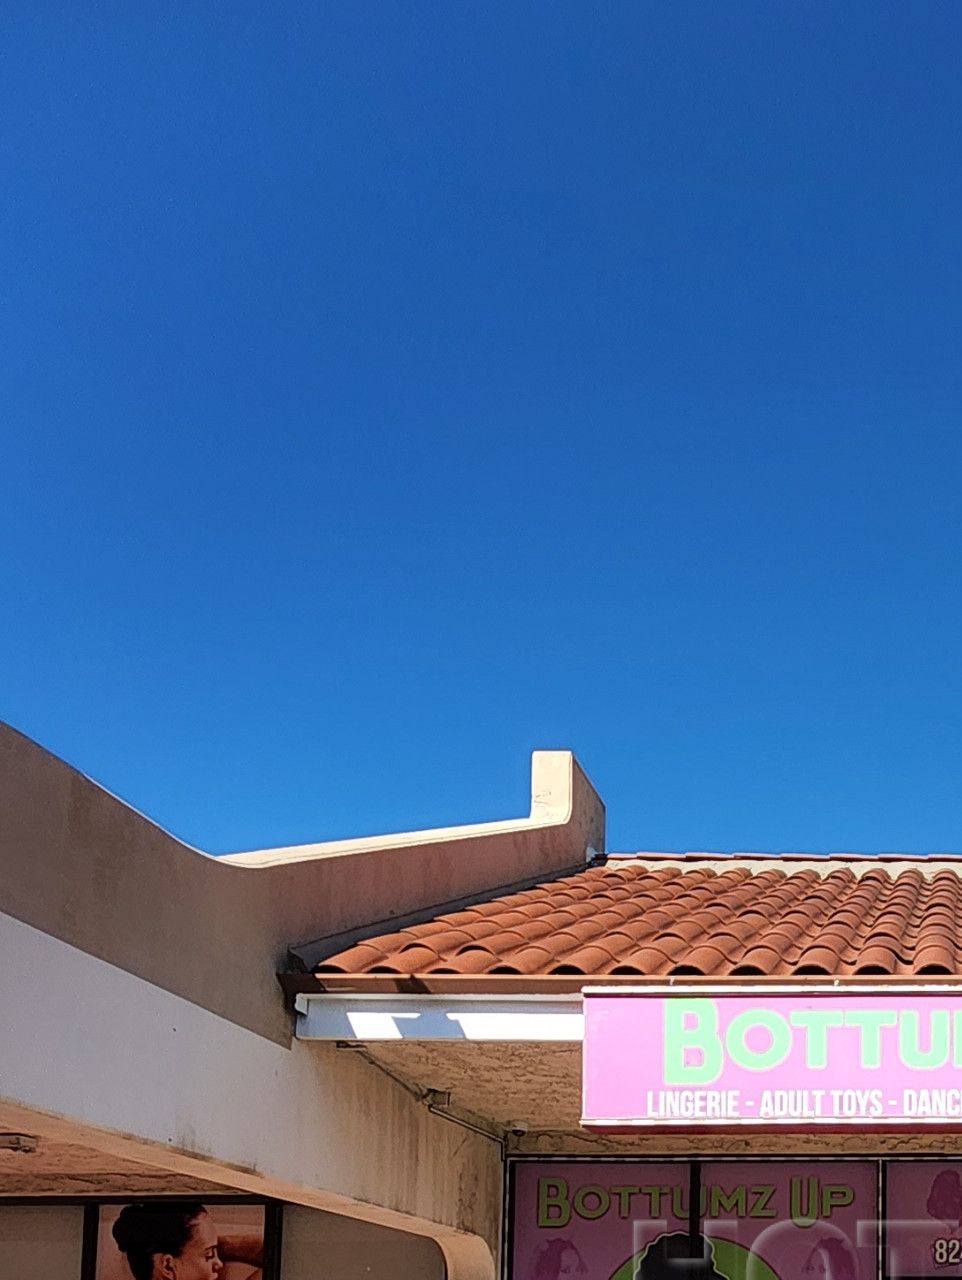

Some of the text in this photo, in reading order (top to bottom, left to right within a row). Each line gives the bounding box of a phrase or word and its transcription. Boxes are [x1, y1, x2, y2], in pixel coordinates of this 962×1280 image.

[647, 1089, 740, 1117] LINGERIE
[760, 1089, 826, 1117] ADULT
[831, 1089, 882, 1117] TOYS
